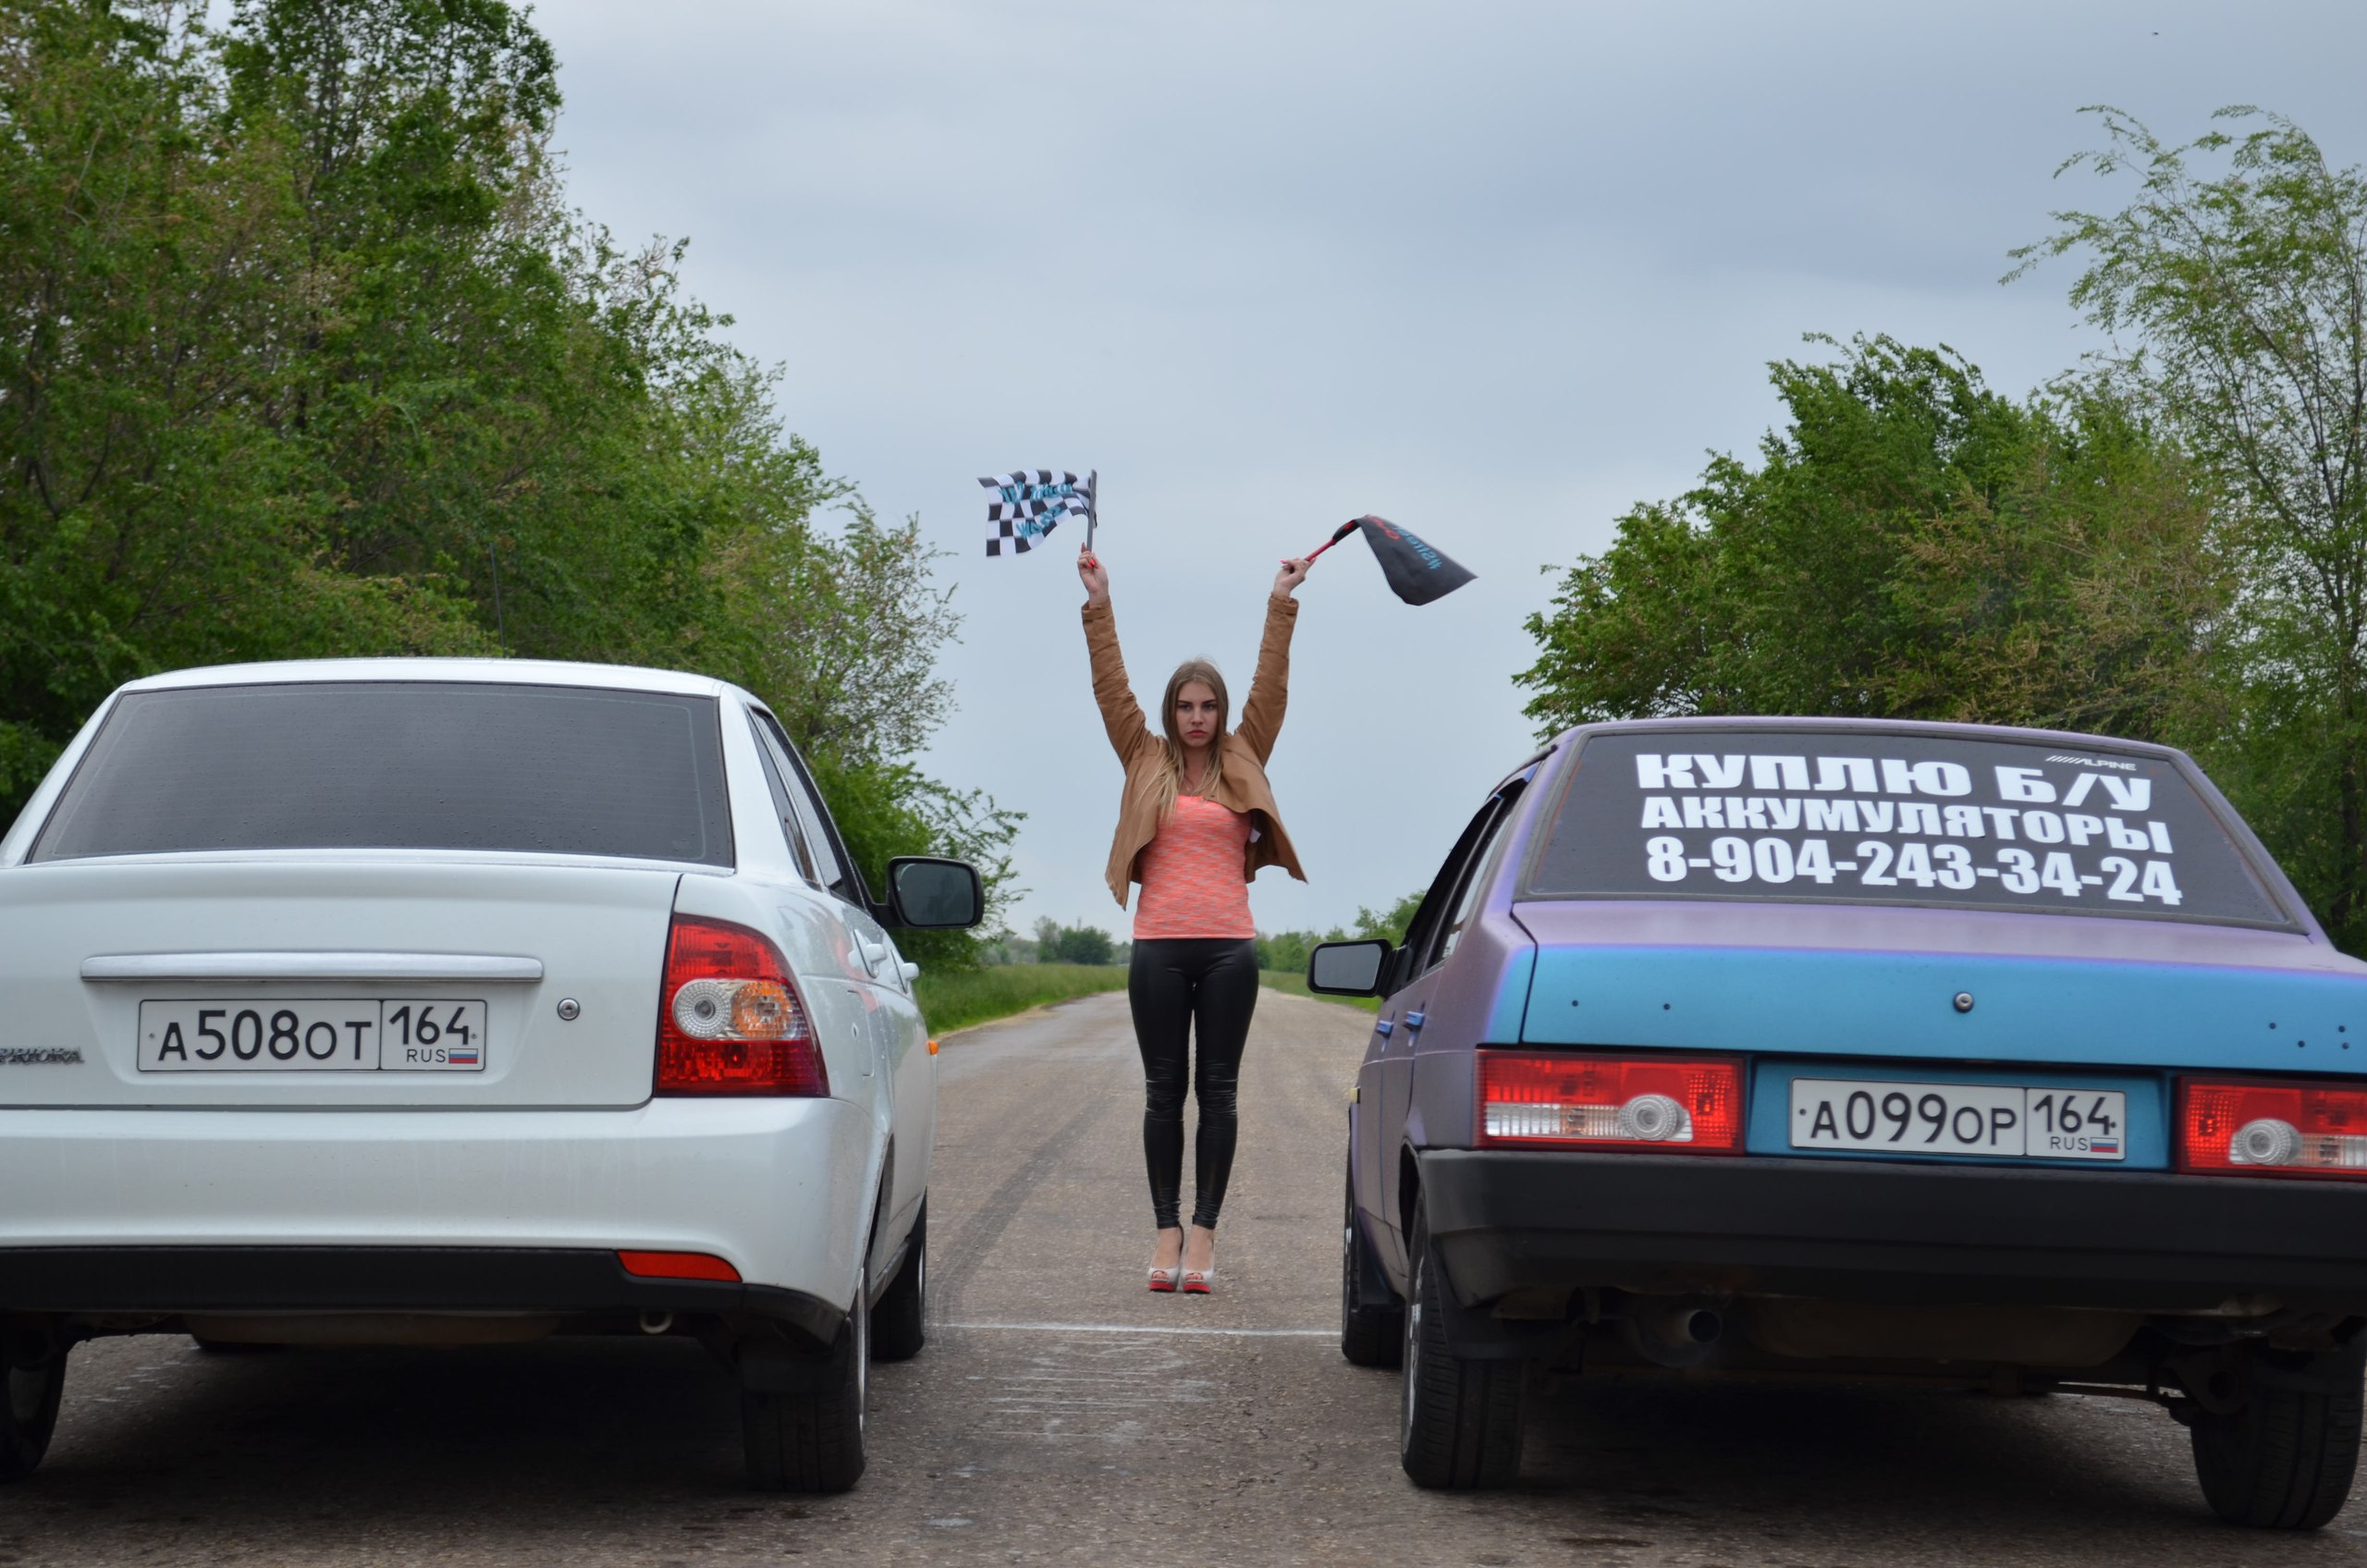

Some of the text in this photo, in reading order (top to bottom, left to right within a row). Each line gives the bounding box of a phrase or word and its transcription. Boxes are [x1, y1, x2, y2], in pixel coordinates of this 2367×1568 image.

[1636, 753, 2152, 813] КУПЛЮ Б/У
[2073, 756, 2138, 771] ALPINE
[1640, 796, 2175, 855] АККУМУЛЯТОРЫ
[1646, 836, 2184, 907] 8-904-243-34-24
[388, 1005, 471, 1047] 164
[406, 1047, 448, 1063] RUS
[2033, 1094, 2112, 1137] 164
[2049, 1135, 2090, 1152] RUS
